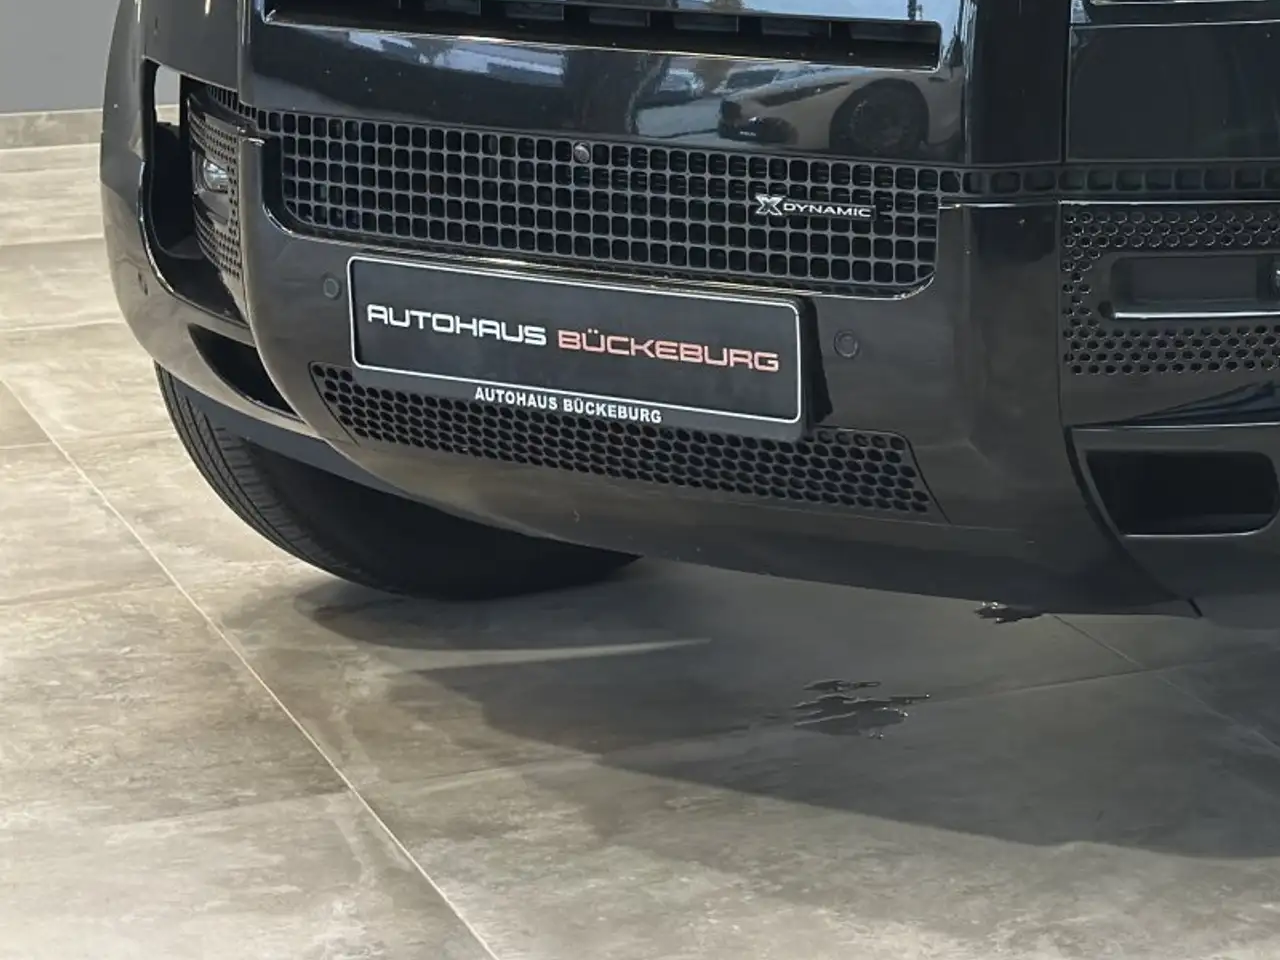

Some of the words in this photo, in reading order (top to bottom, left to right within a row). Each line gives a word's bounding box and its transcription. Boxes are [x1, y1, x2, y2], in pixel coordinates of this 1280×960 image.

[366, 303, 547, 347] AUTOHAUS
[556, 327, 780, 372] BÜCKEBURG
[474, 386, 559, 411] AUTOHAUS
[562, 396, 663, 425] BÜCKEBURG
